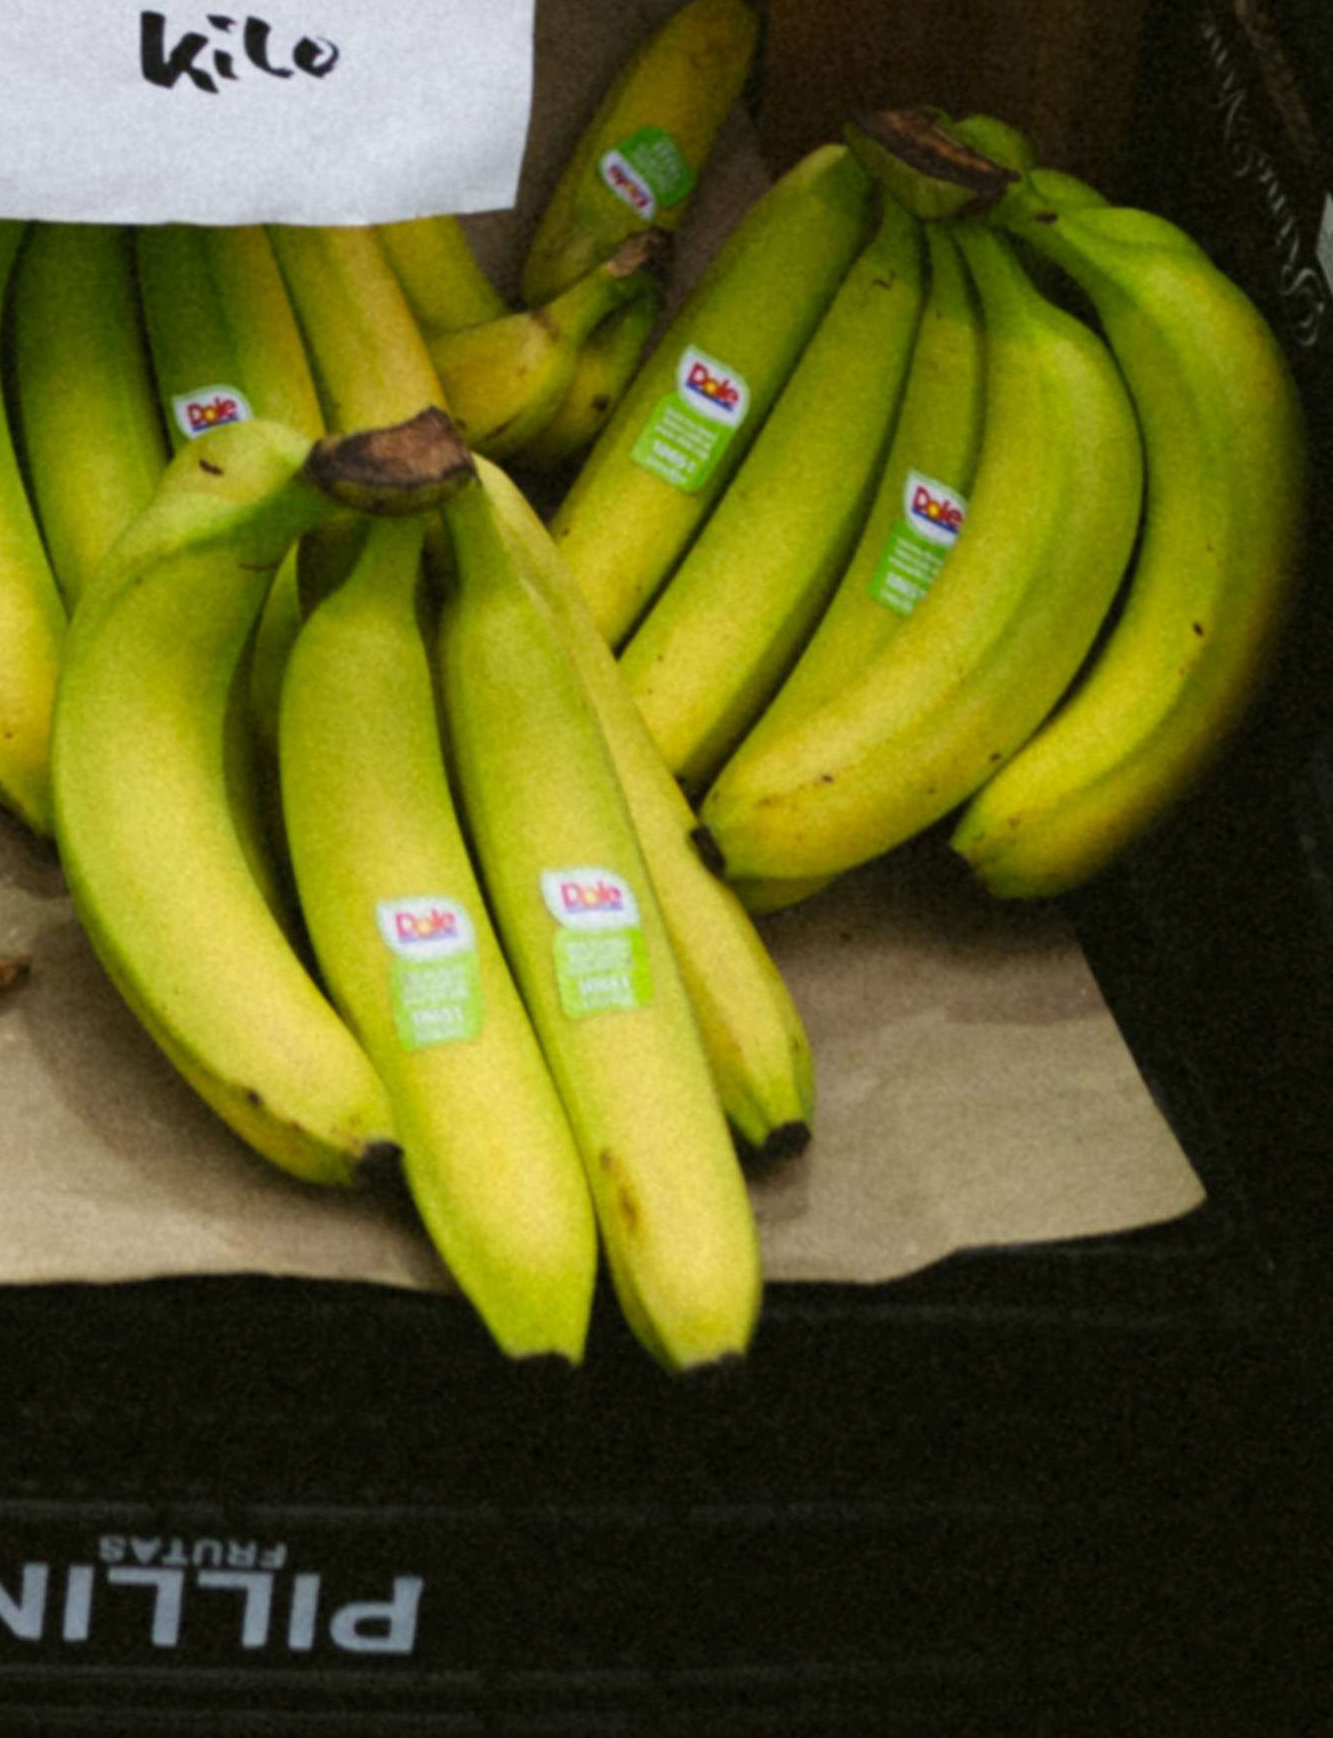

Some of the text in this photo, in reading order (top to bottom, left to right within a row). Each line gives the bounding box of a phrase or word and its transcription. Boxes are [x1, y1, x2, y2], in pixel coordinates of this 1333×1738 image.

[688, 361, 739, 406] Dole
[187, 396, 237, 428] Dole
[913, 485, 964, 530] Dole
[561, 880, 621, 909] Dole
[395, 909, 456, 939] Dole
[98, 1535, 287, 1569] FRUTAS
